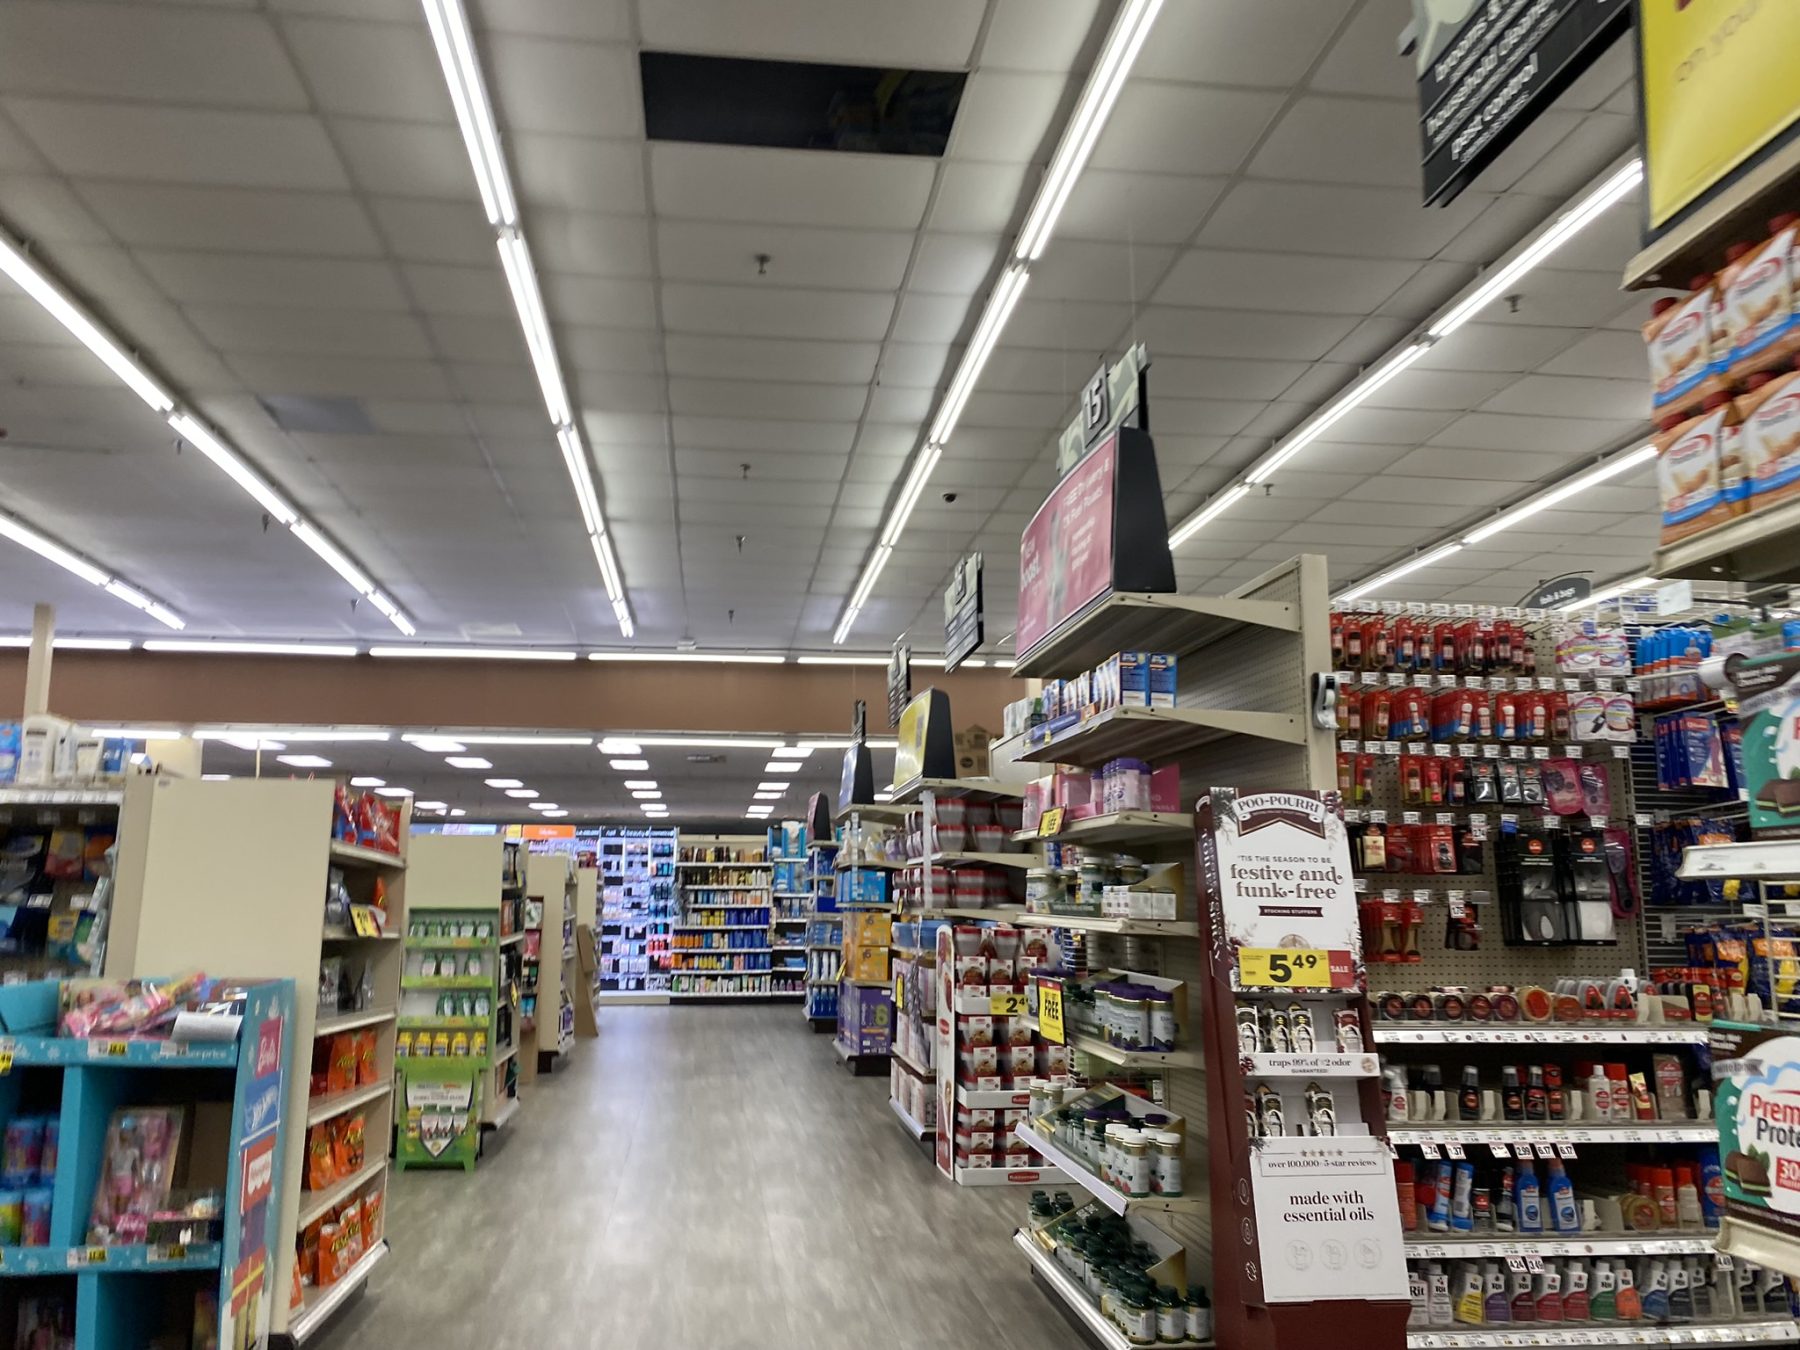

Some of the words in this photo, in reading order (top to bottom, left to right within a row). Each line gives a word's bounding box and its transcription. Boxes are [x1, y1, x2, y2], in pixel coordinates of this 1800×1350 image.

[1426, 45, 1498, 137] household
[1483, 52, 1538, 121] control
[1084, 378, 1103, 429] 15
[1237, 796, 1319, 813] POO-POURRI
[1230, 863, 1294, 880] festive
[1299, 866, 1343, 885] and
[1236, 881, 1336, 899] funk-free
[1330, 965, 1349, 973] SALE
[1045, 999, 1059, 1020] FREE
[1269, 1059, 1291, 1068] traps
[1310, 1058, 1319, 1066] of
[1331, 1058, 1352, 1066] odor
[1290, 1191, 1330, 1205] made
[1332, 1190, 1364, 1204] with
[1283, 1207, 1347, 1222] essential
[1349, 1207, 1374, 1221] oils
[1410, 1286, 1424, 1296] Rit
